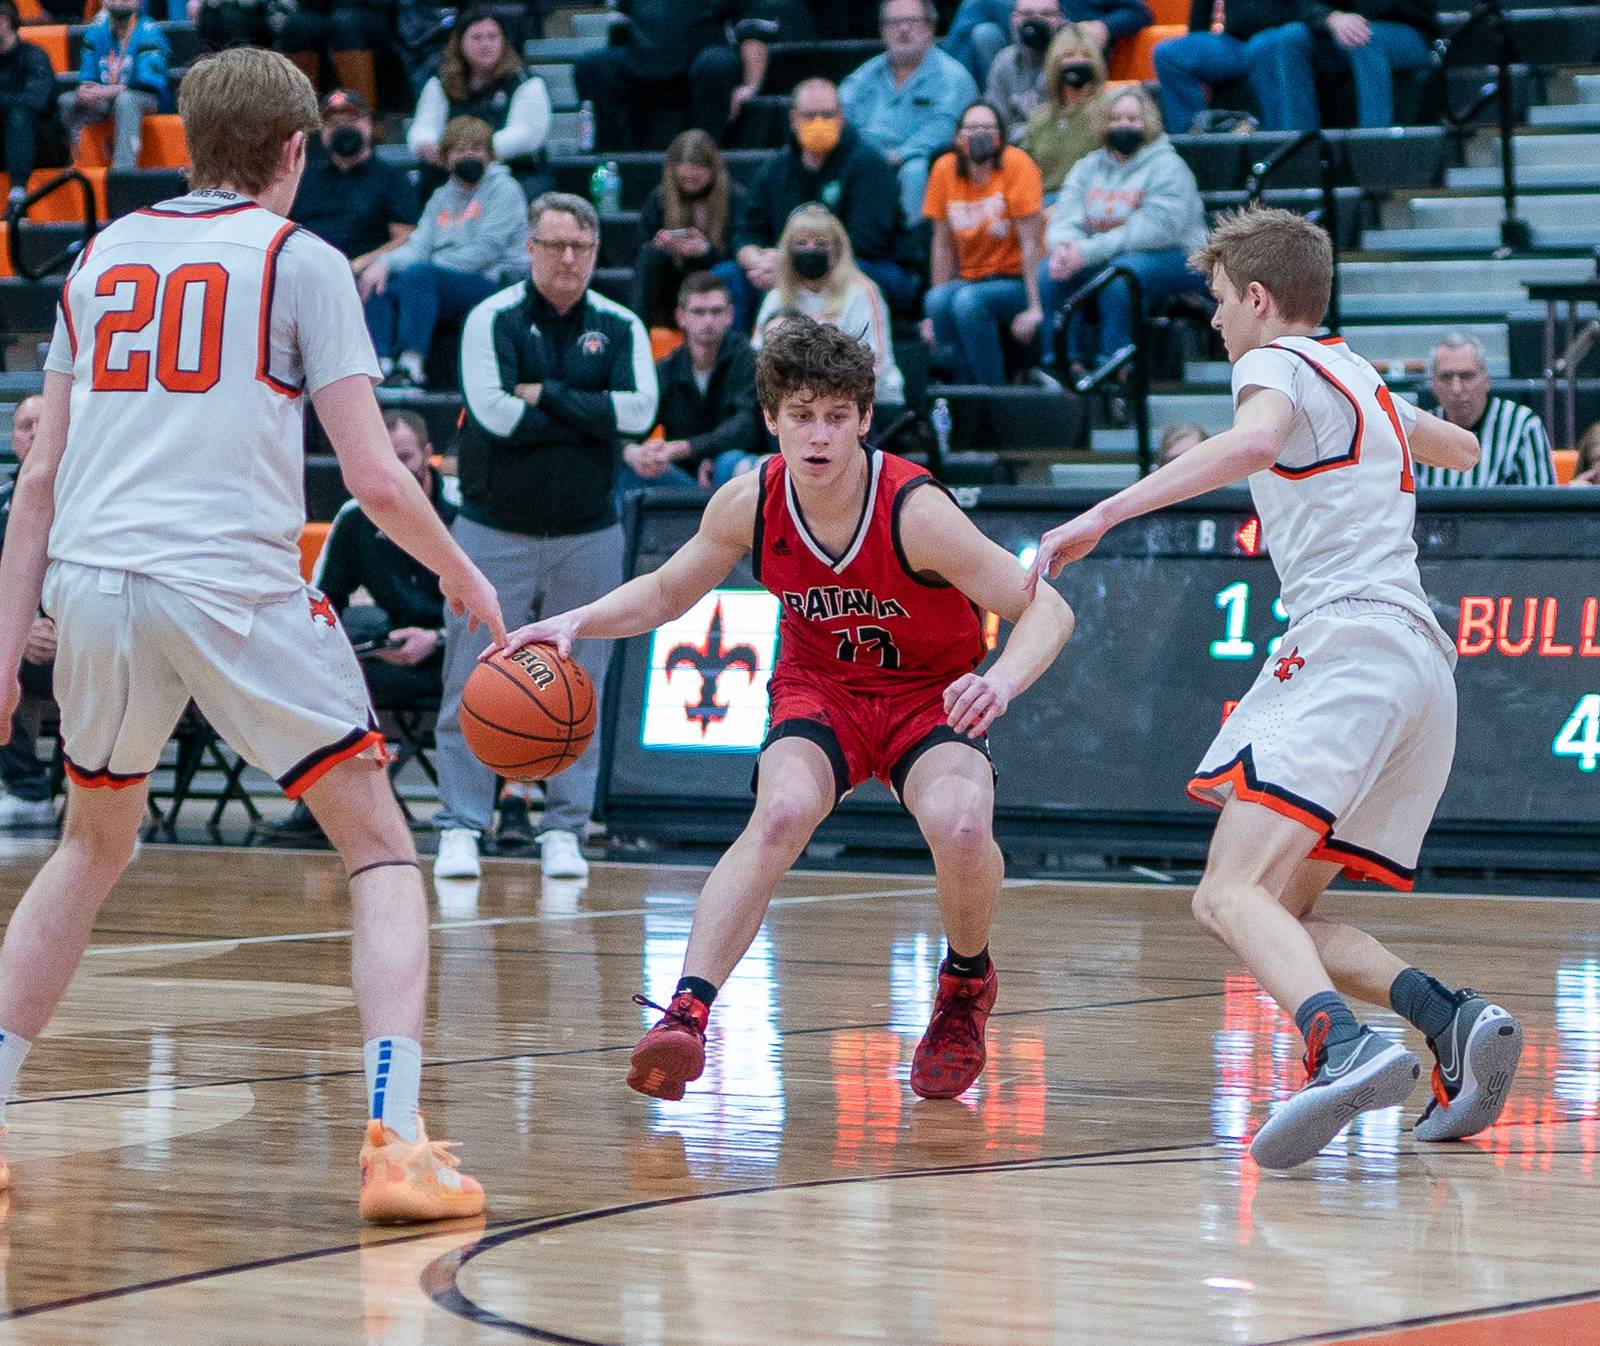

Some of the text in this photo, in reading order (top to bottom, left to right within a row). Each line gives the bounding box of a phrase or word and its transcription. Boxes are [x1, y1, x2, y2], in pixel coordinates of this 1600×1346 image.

[212, 190, 237, 200] PRO
[91, 263, 229, 393] 20
[782, 585, 911, 621] BATAVIA
[1457, 596, 1600, 656] BULL
[1552, 693, 1600, 772] 4
